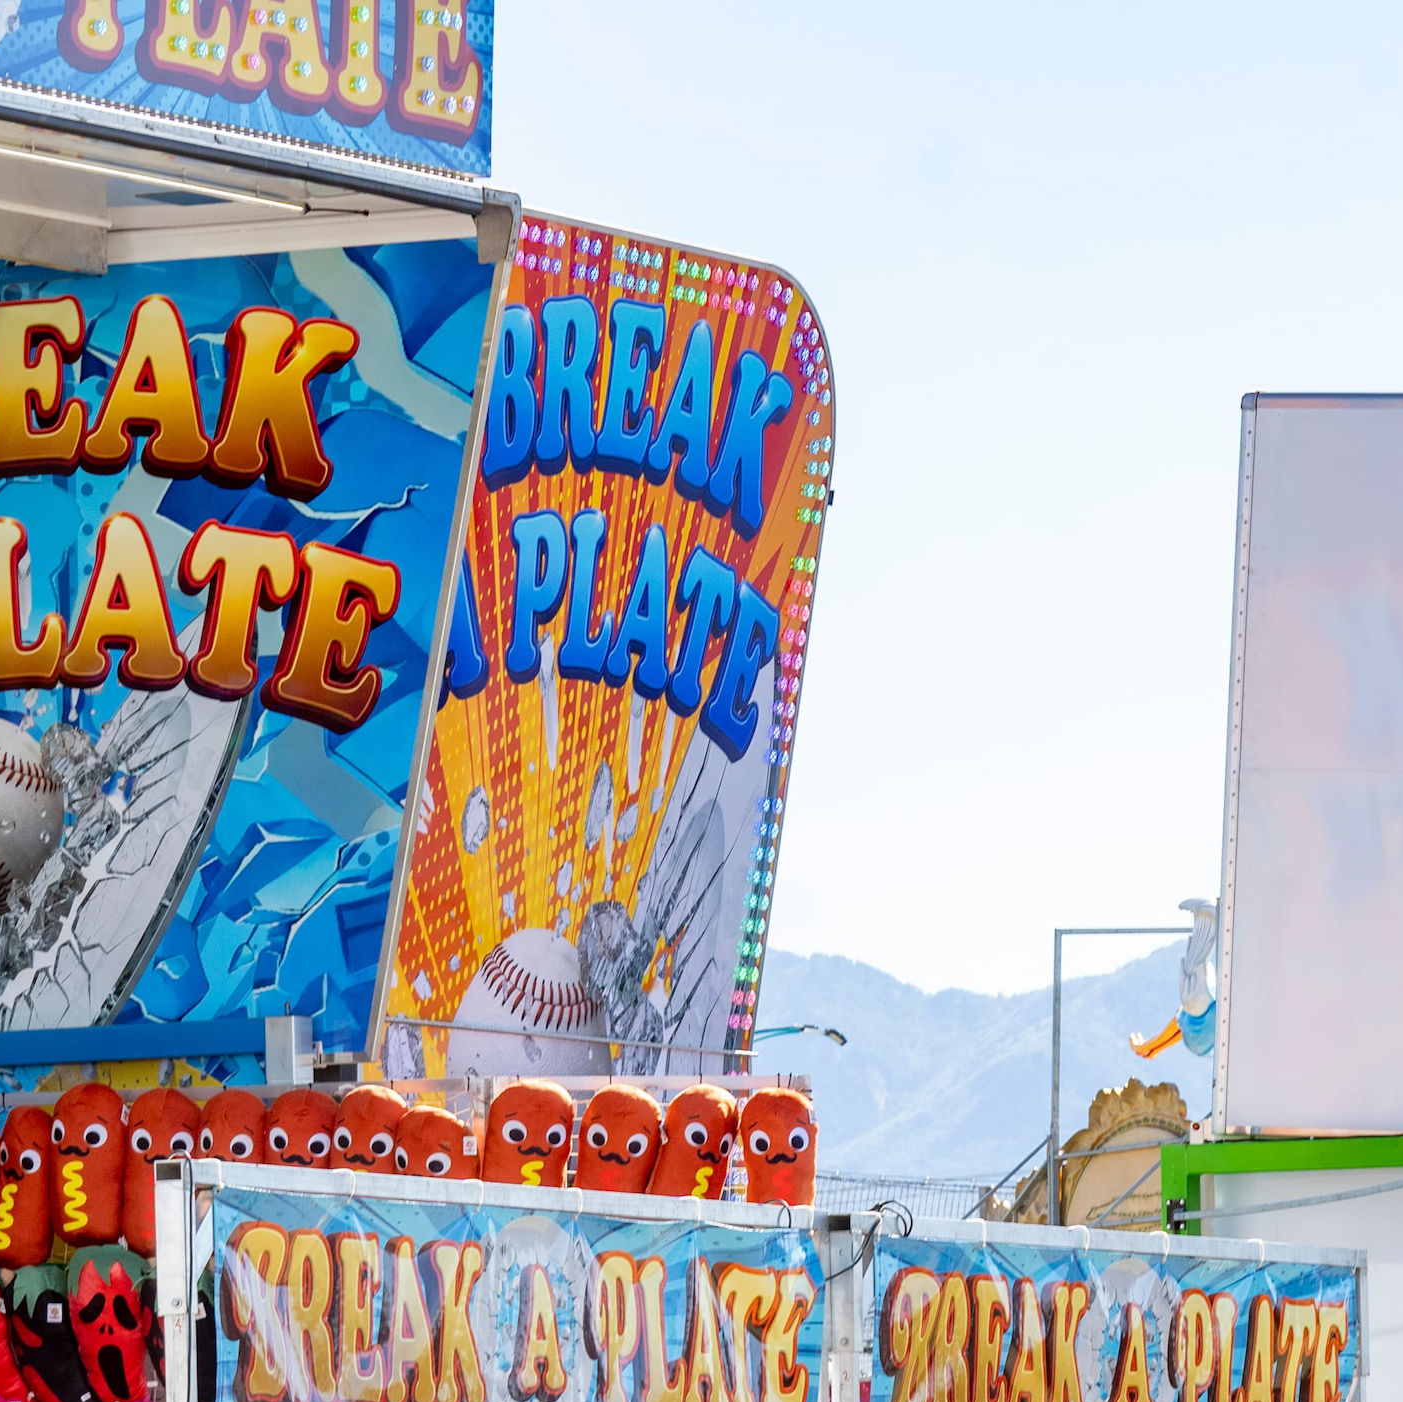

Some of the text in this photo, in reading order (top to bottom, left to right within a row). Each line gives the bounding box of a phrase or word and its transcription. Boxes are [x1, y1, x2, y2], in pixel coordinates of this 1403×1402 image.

[481, 293, 794, 541] BREAK
[505, 508, 782, 764] PLATE
[509, 1263, 568, 1402] A
